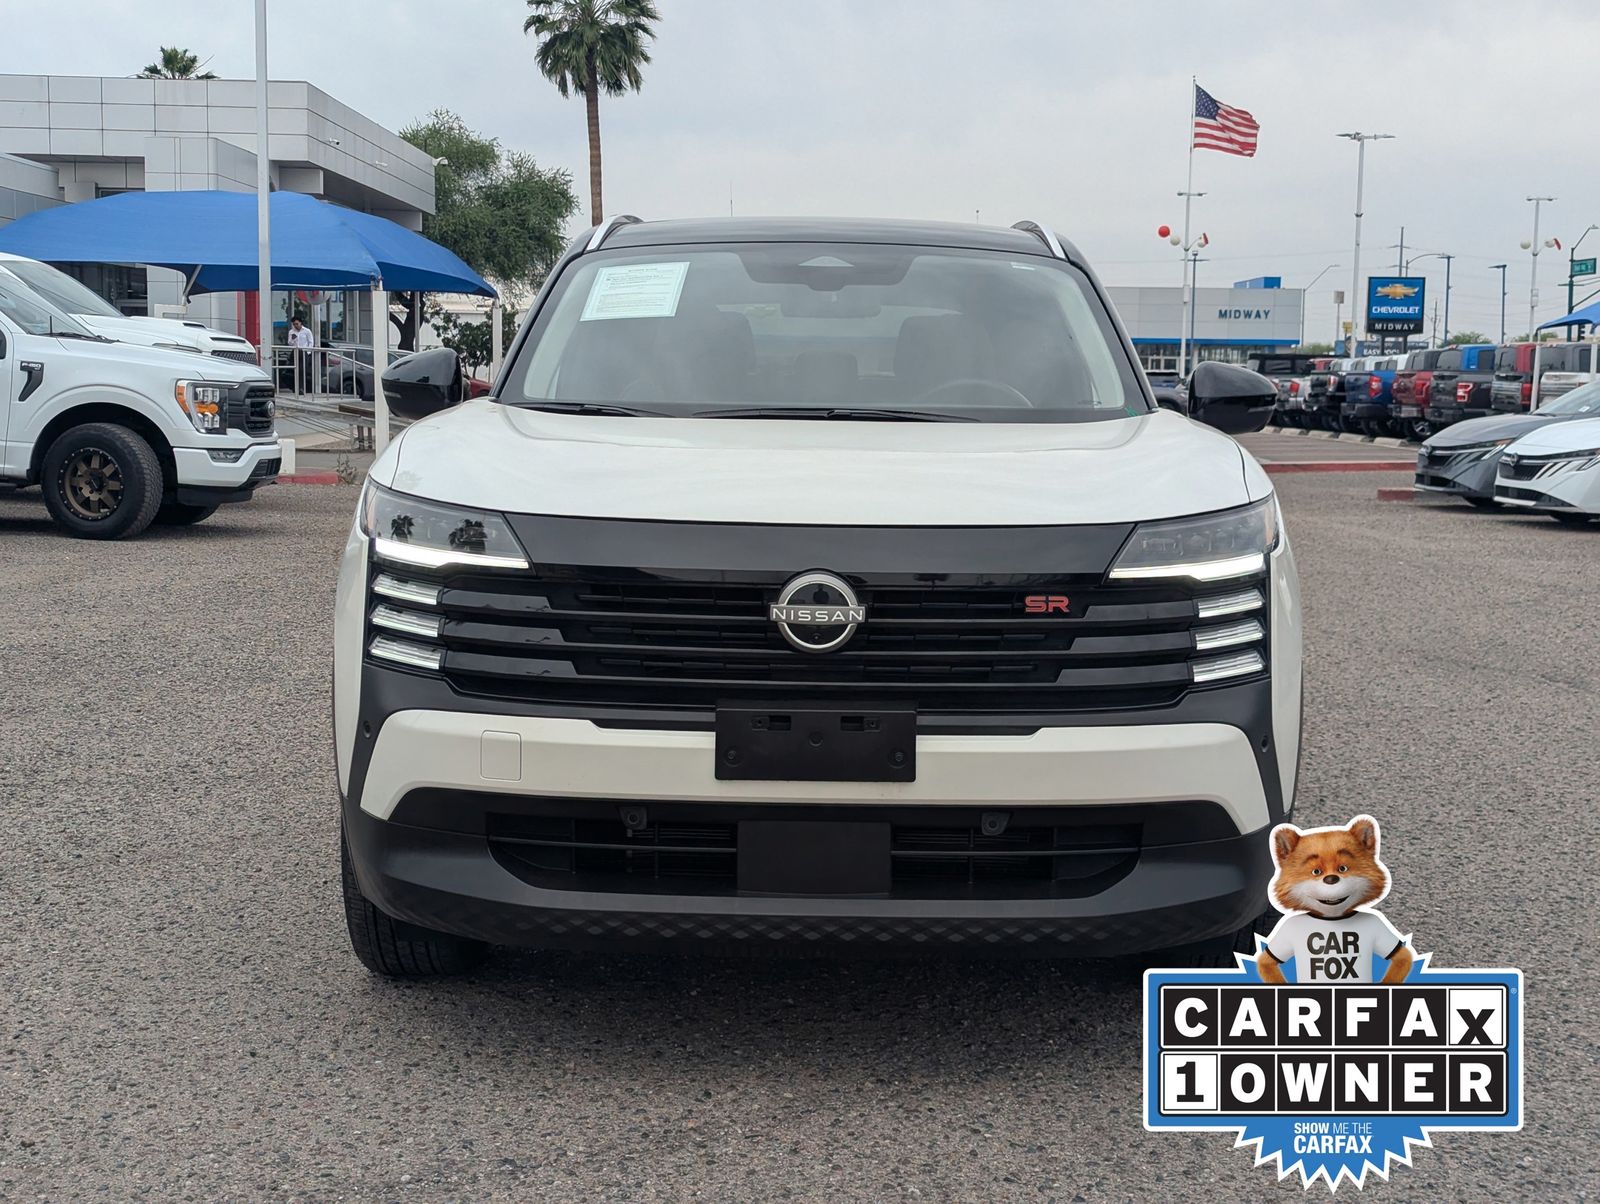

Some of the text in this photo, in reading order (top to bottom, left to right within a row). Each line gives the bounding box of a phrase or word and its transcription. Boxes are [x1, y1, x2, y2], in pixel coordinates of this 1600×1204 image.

[1218, 309, 1271, 319] MIDWAY
[1372, 306, 1420, 314] CHEVROLET
[1025, 596, 1069, 612] SR
[772, 607, 863, 622] NISSAN
